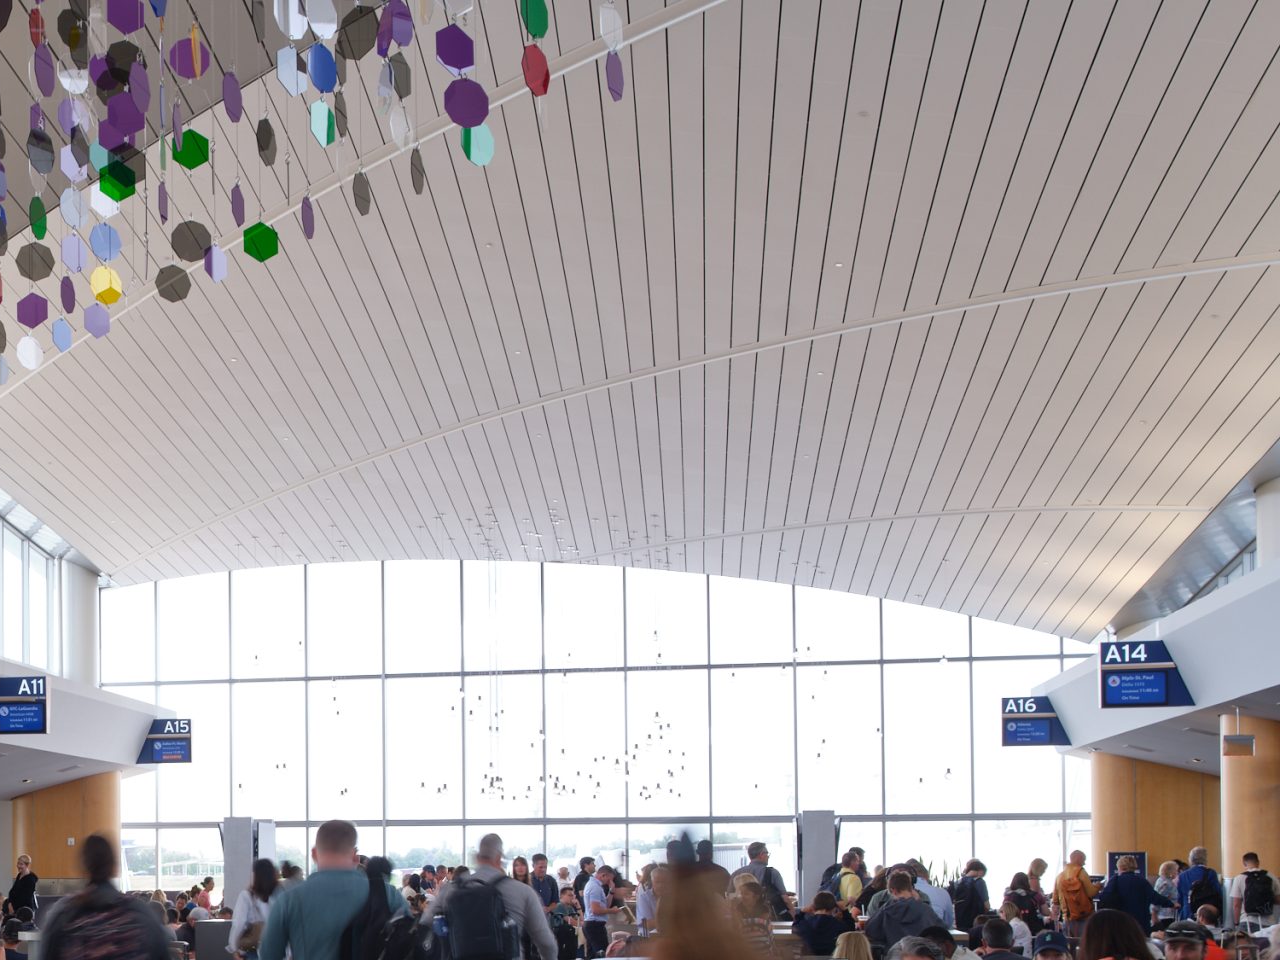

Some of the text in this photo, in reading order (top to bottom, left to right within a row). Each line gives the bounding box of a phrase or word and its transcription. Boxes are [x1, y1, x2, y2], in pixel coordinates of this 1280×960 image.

[1104, 643, 1148, 663] A14
[18, 678, 44, 695] A11
[1005, 698, 1037, 713] A16
[163, 720, 190, 734] A15
